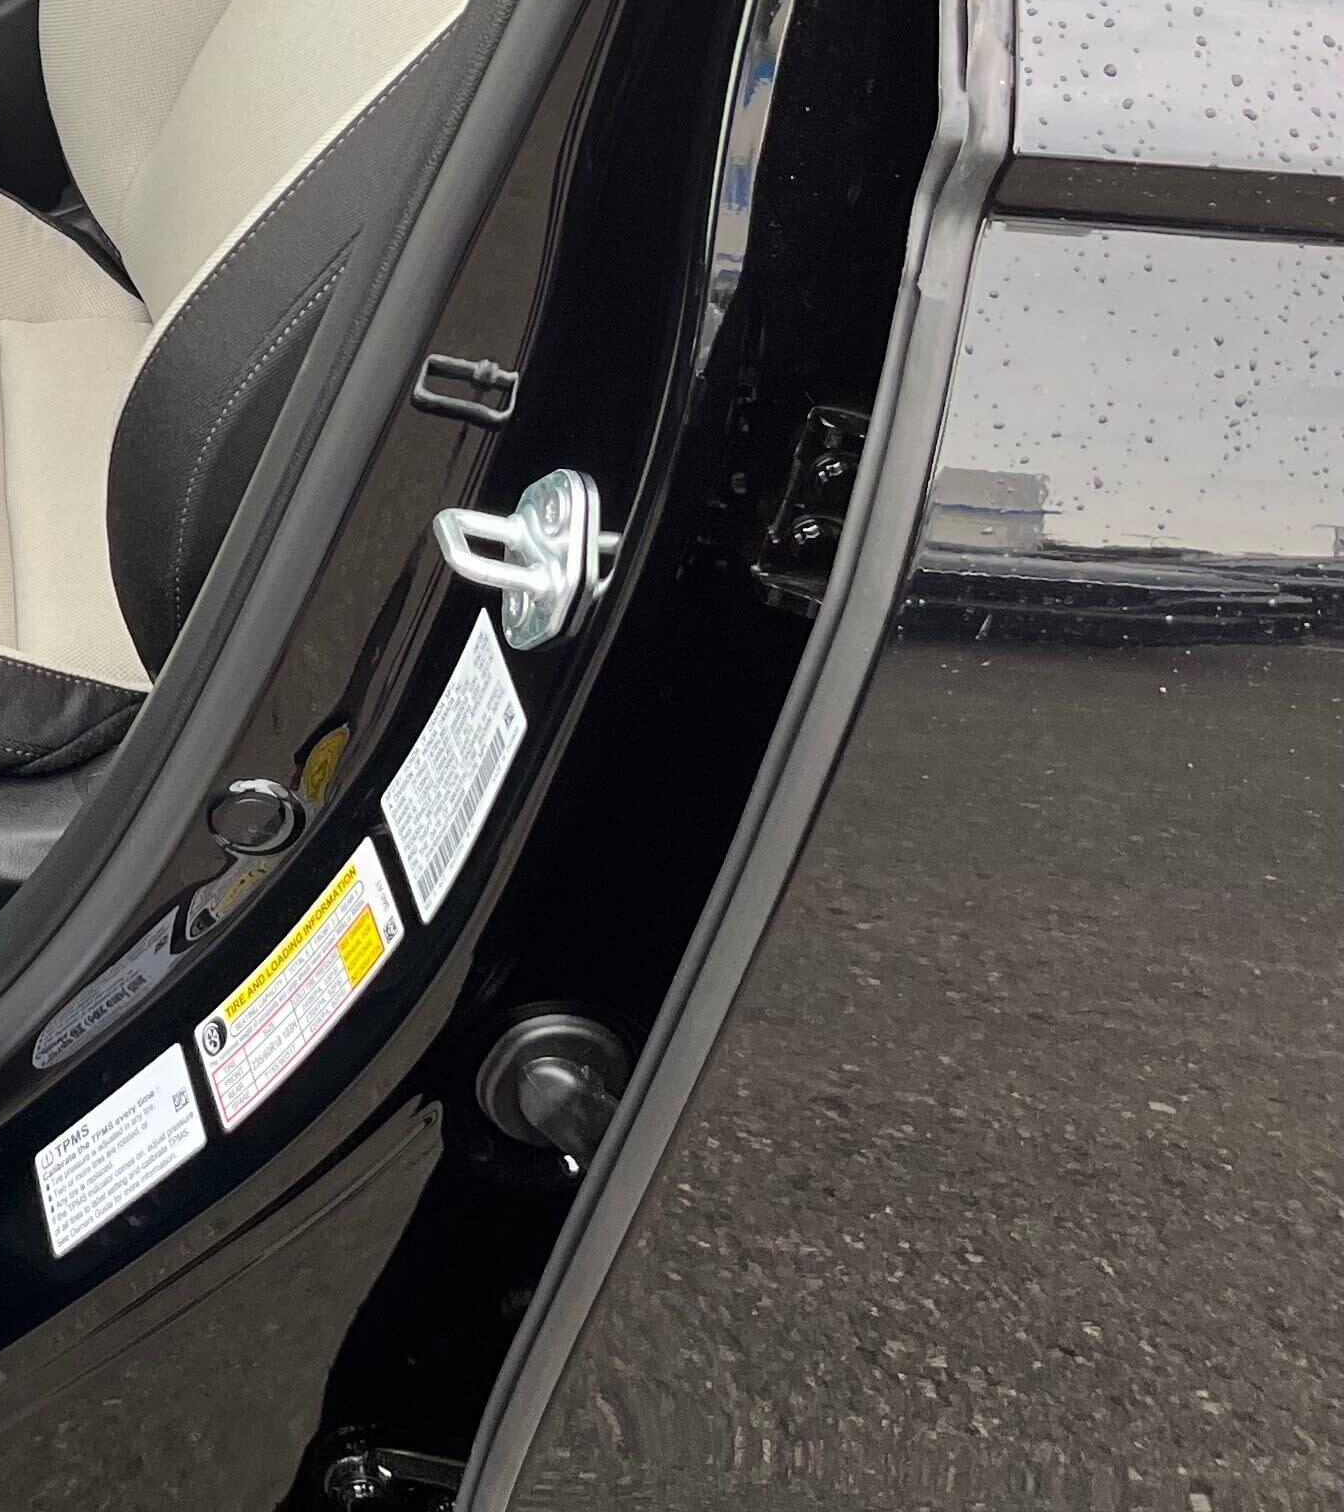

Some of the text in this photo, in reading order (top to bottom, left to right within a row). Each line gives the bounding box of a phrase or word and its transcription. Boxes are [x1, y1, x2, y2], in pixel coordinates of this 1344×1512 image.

[225, 992, 245, 1019] TIRE
[246, 972, 265, 998] AND
[265, 931, 303, 978] LOADING
[302, 865, 356, 935] INFORMATION
[55, 1122, 89, 1158] TPMS
[77, 1139, 89, 1155] the
[91, 1120, 113, 1143] TPMS
[114, 1104, 136, 1126] every
